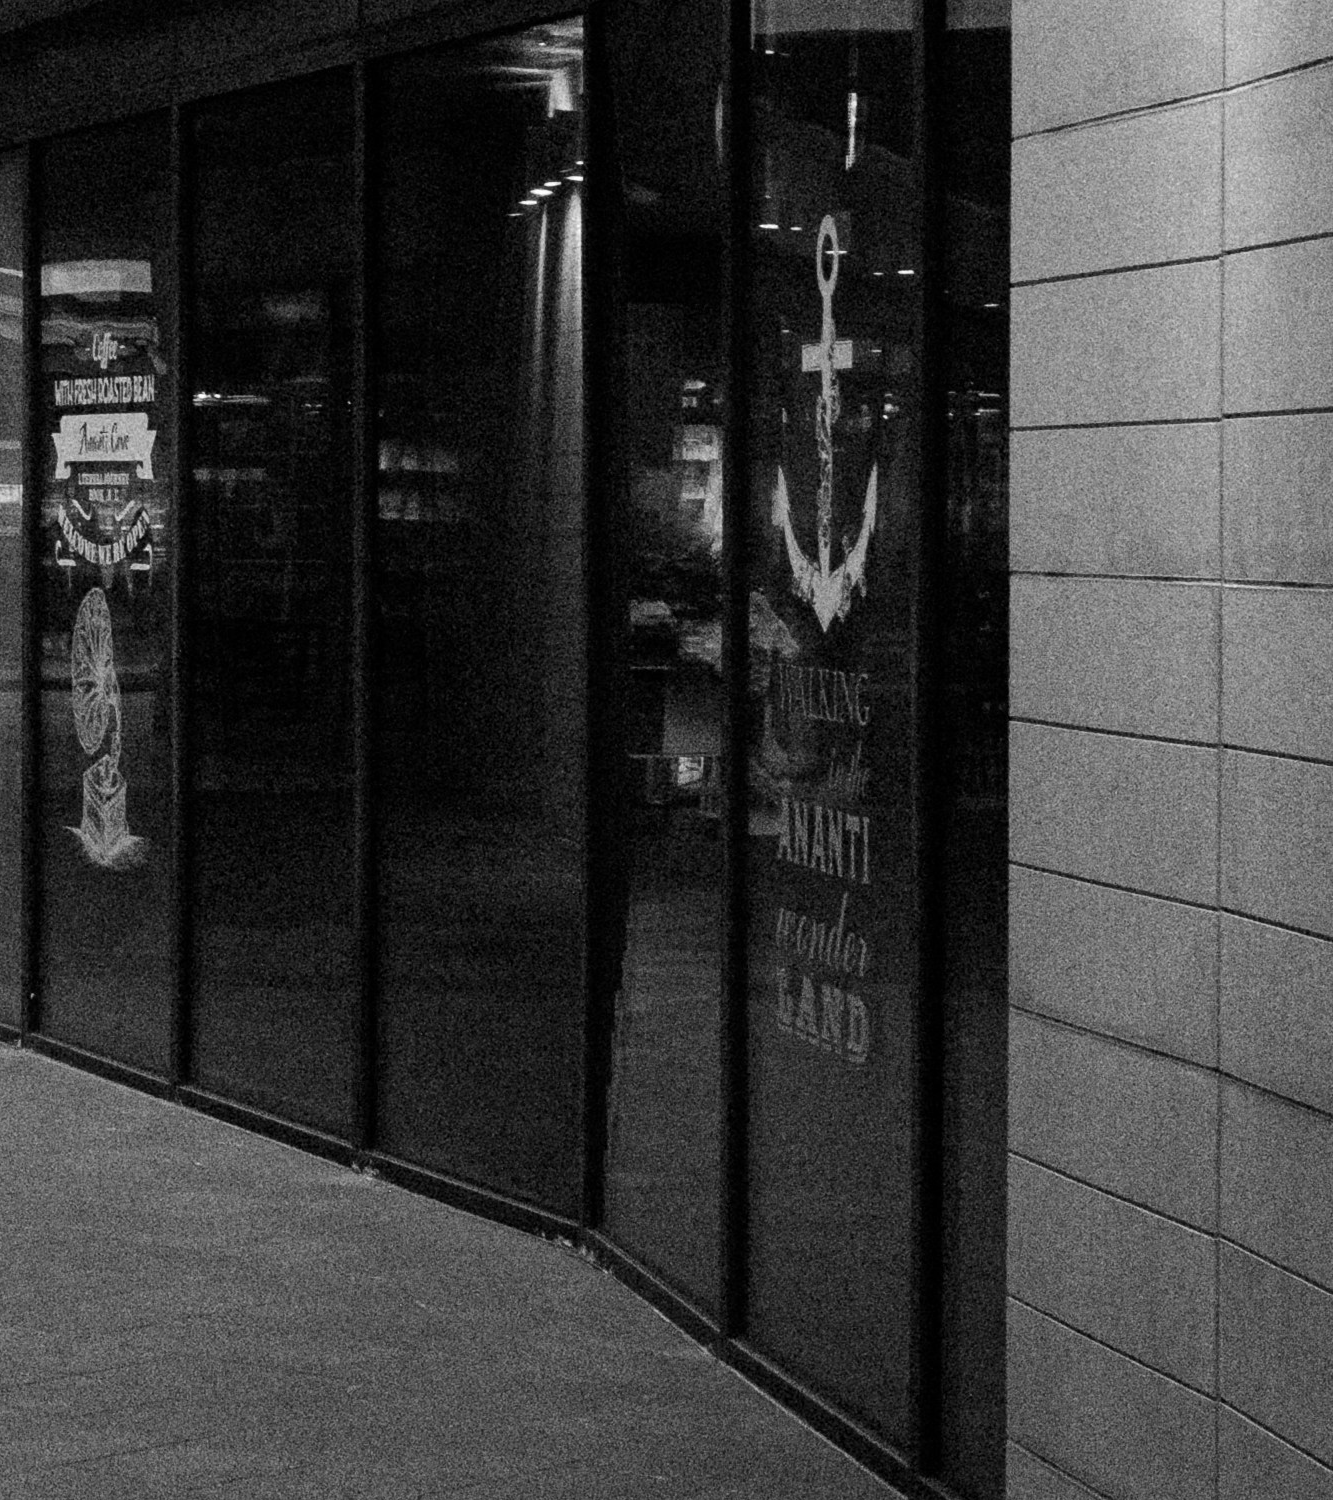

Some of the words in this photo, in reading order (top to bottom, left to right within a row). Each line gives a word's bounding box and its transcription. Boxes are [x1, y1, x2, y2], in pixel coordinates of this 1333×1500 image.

[54, 380, 73, 406] WITH
[74, 378, 97, 405] FRESH
[98, 376, 132, 404] ROASTED
[777, 663, 870, 728] WALKING
[776, 796, 871, 884] ANANTI
[776, 891, 868, 978] wonder
[776, 966, 870, 1063] LAND
